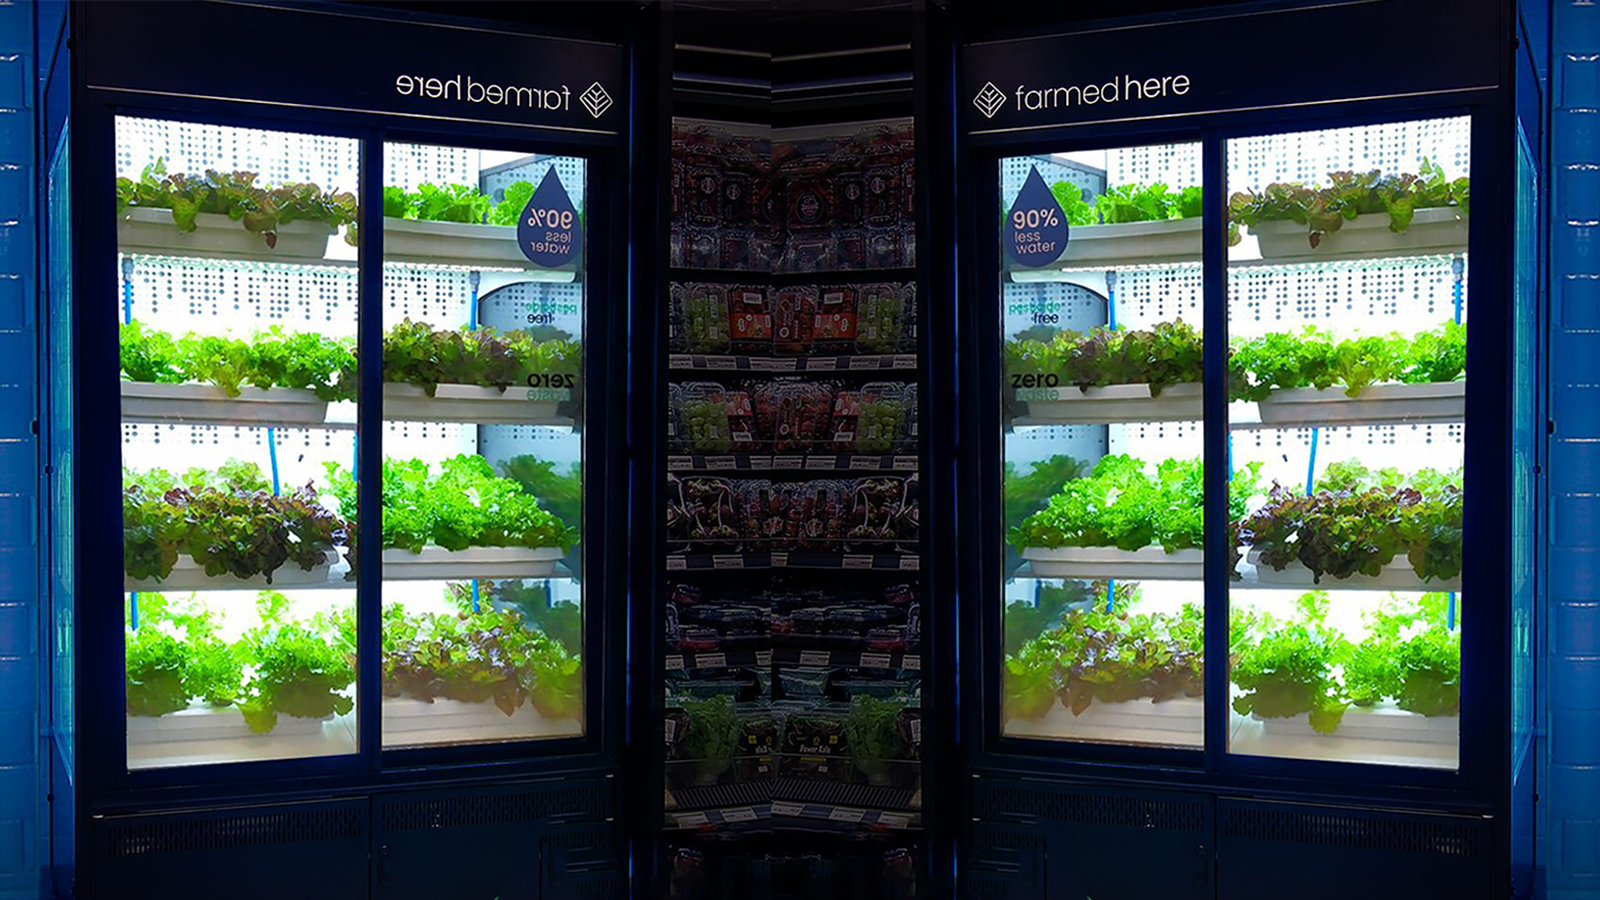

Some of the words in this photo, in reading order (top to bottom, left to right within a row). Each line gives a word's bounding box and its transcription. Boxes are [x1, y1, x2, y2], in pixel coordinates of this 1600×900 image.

[1013, 208, 1059, 230] 90%
[1014, 231, 1041, 243] less
[1016, 241, 1056, 254] water
[1034, 312, 1059, 324] free
[1011, 373, 1059, 388] zero
